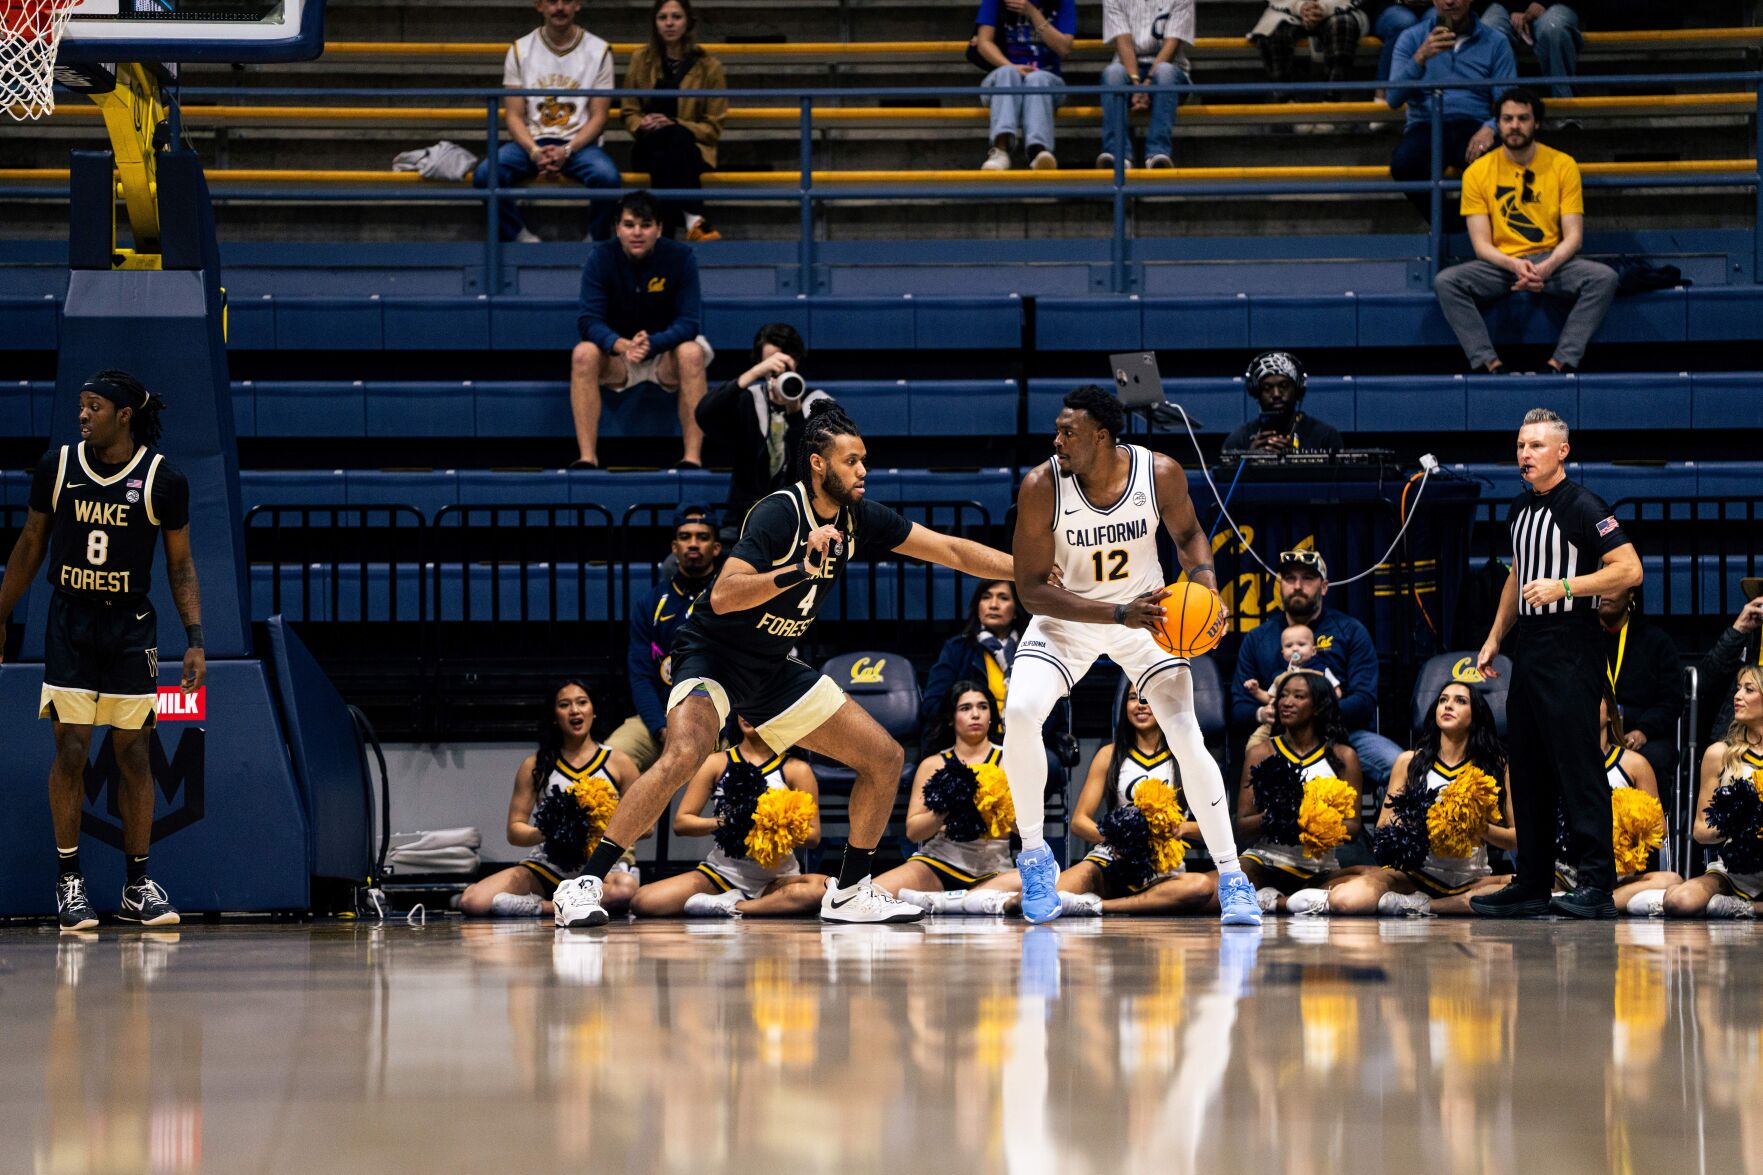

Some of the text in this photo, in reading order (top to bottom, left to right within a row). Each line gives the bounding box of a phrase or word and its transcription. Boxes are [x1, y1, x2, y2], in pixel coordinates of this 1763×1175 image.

[647, 277, 666, 292] Cal
[74, 500, 130, 527] WAKE
[1066, 518, 1147, 547] CALIFORNIA
[86, 530, 109, 566] 8
[60, 564, 130, 593] FOREST
[1092, 549, 1129, 582] 12
[797, 584, 818, 616] 4
[850, 656, 886, 684] Cal
